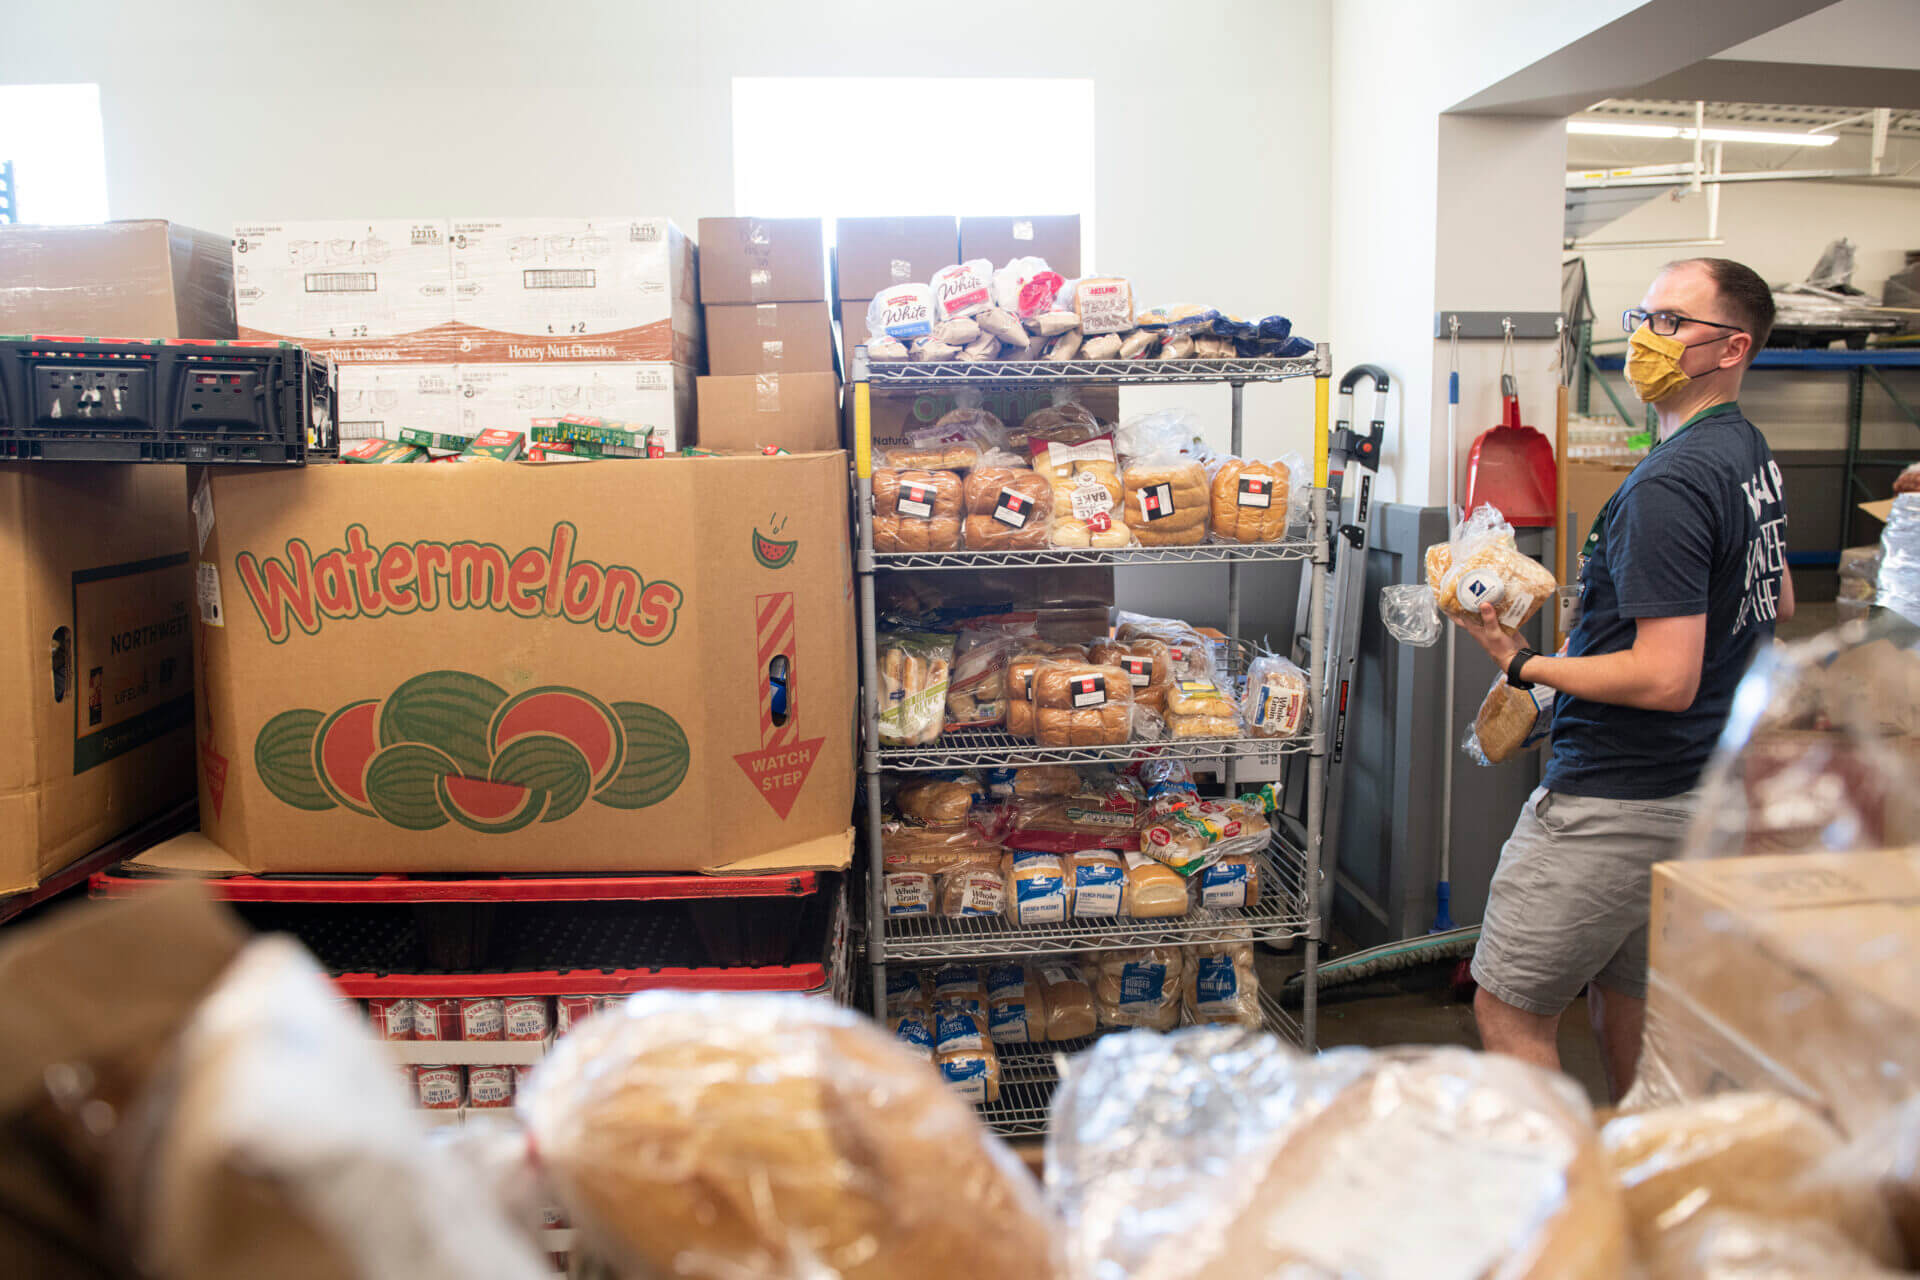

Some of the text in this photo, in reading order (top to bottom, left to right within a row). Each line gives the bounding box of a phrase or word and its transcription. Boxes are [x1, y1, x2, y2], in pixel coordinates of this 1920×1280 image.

[936, 275, 984, 301] White
[881, 304, 928, 326] White
[508, 343, 617, 361] Honey Nut Cheerios
[1074, 490, 1108, 506] BAKE
[237, 521, 684, 647] Watermelons
[1266, 695, 1278, 721] Grain
[1276, 695, 1289, 724] Whole
[751, 749, 811, 773] WATCH
[762, 770, 802, 791] STEP
[894, 887, 921, 896] Whole
[896, 894, 920, 903] Grain
[971, 890, 998, 900] Whole
[971, 897, 995, 906] Grain
[515, 1019, 538, 1028] DICED
[428, 1088, 450, 1098] DICED
[478, 1087, 500, 1097] DICED
